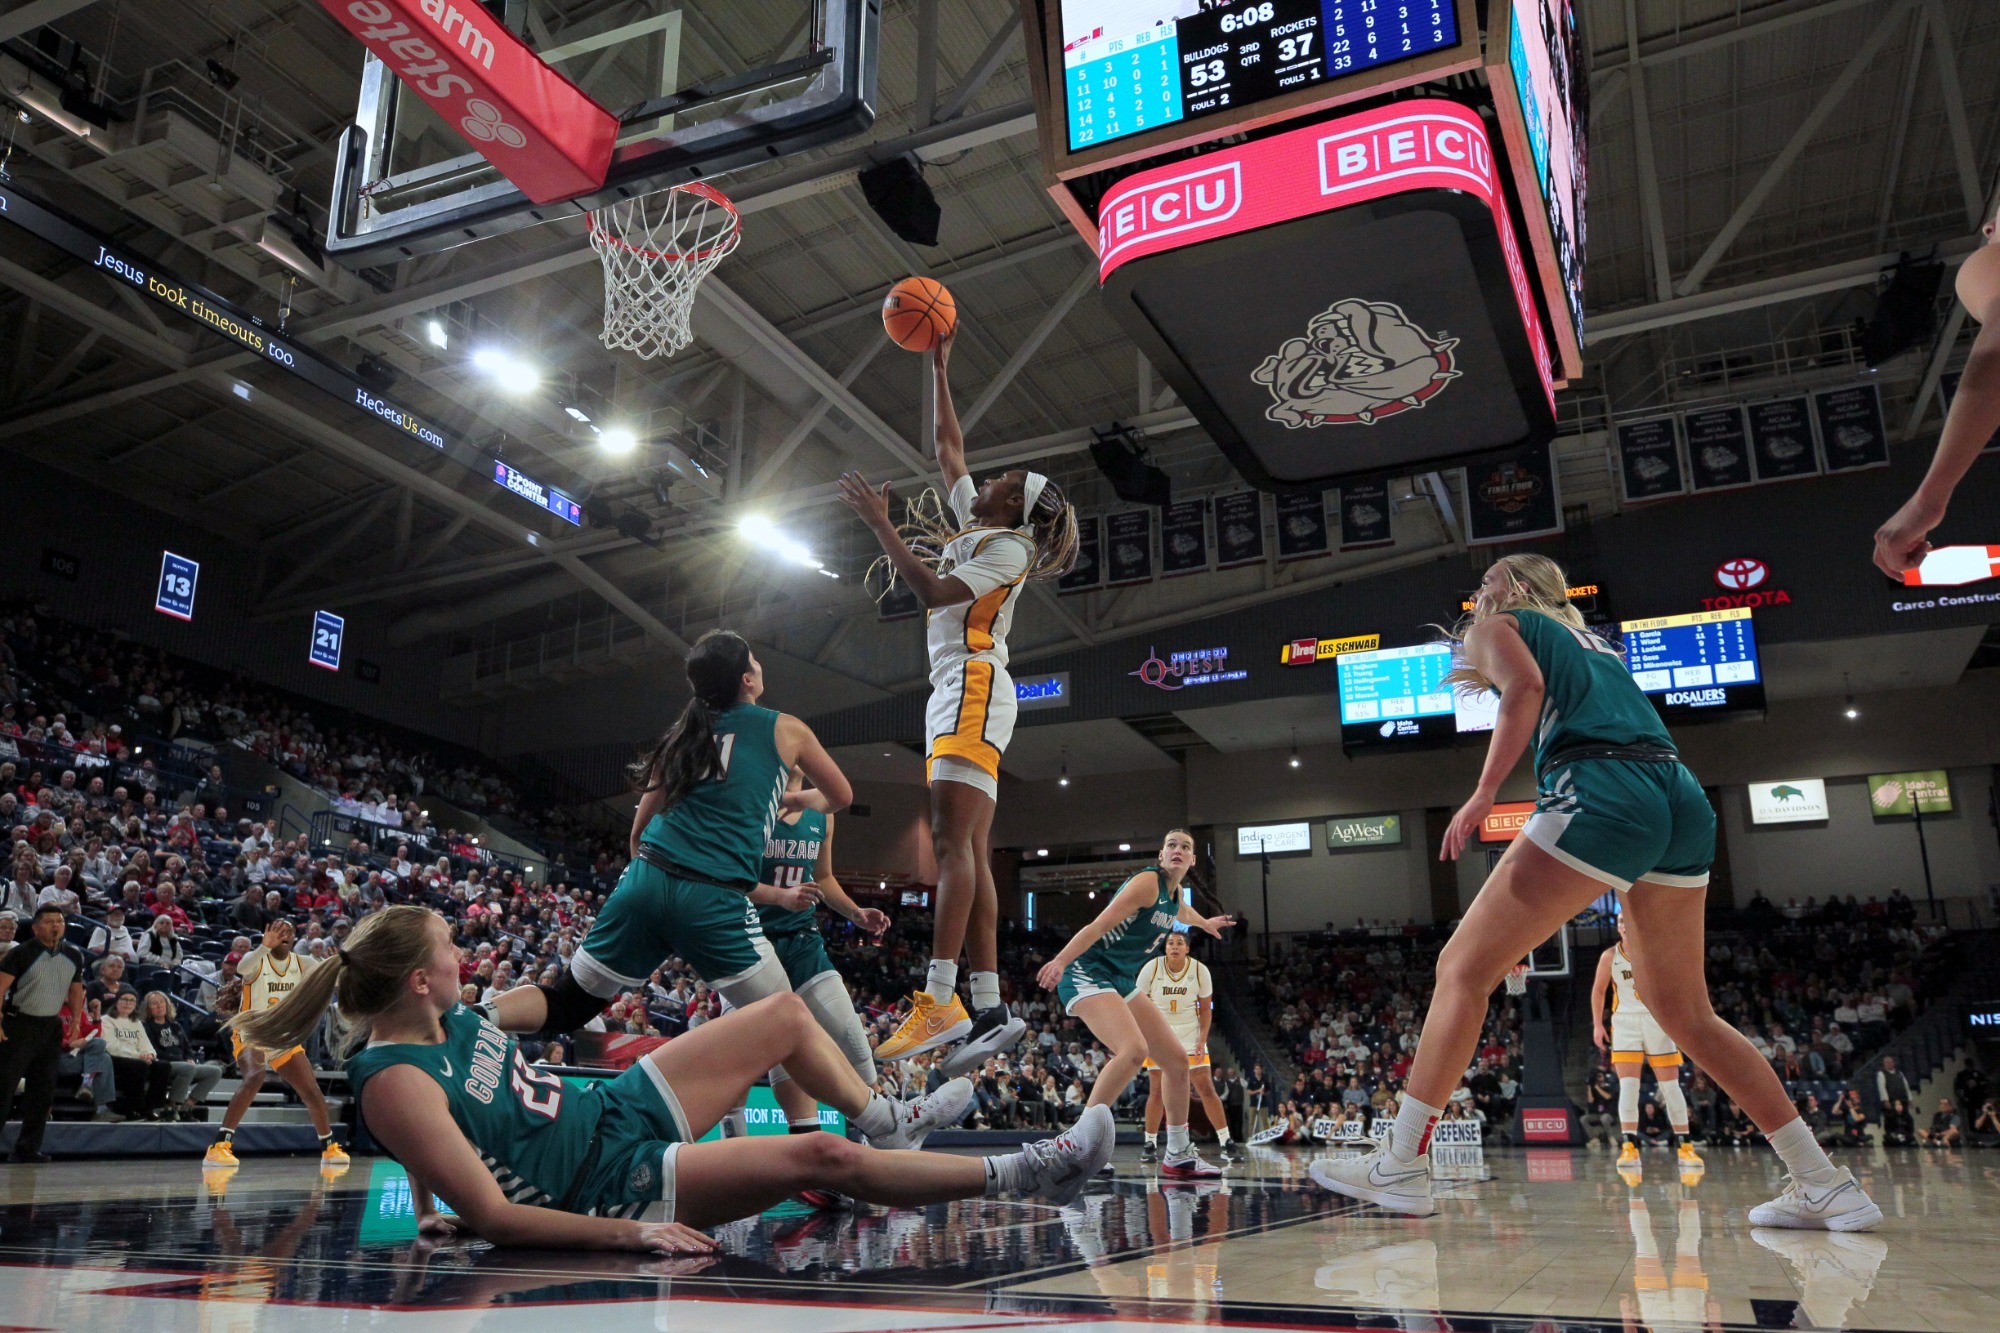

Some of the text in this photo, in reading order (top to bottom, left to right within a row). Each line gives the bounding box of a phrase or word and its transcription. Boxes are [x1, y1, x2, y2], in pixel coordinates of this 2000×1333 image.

[1220, 2, 1275, 33] 6:08
[1334, 0, 1378, 21] 2 11
[1271, 16, 1318, 38] ROCKETS
[1336, 6, 1408, 37] 5 9 3
[1109, 25, 1173, 53] PTS REB FLS
[1333, 13, 1441, 54] 22 6 1 3
[347, 0, 474, 98] State
[1184, 43, 1229, 64] BULLDOGS
[1239, 42, 1260, 55] 3RD
[1278, 32, 1314, 62] 37
[1334, 30, 1443, 70] 33 4 2 3
[1079, 45, 1167, 81] 5 3 2 1
[1241, 54, 1260, 67] QTR
[1077, 60, 1168, 97] 11 10 0 1
[1190, 60, 1226, 87] 53
[1279, 67, 1321, 87] FOULS 1
[1077, 75, 1169, 112] 12 4 5 2
[1191, 94, 1230, 112] FOULS 2
[1079, 90, 1171, 127] 14 5 2 0
[1079, 107, 1172, 143] 22 11 5 1
[1337, 130, 1489, 177] BECU
[94, 246, 295, 367] Jesus took timeouts, too.
[356, 388, 443, 448] HeGetsUs.com
[507, 479, 548, 507] COUNTER
[508, 470, 543, 495] 3-POINT
[1488, 484, 1509, 495] FINAL
[556, 501, 562, 511] 4
[166, 574, 191, 597] 13
[1701, 590, 1791, 611] TOYOTA
[1892, 600, 1935, 611] Garco
[1630, 610, 1740, 629] ON THE FLOOR PTS REB FLS
[316, 628, 338, 650] 21
[1640, 630, 1661, 638] Garcia
[1292, 643, 1315, 658] Tires
[1319, 639, 1376, 654] LES SCHWAB
[1641, 645, 1666, 653] Lockett
[1128, 646, 1227, 690] QUEST
[1727, 663, 1741, 671] AST
[1016, 678, 1061, 699] bank
[1665, 688, 1726, 705] ROSAUERS
[1906, 780, 1936, 789] Idaho
[1907, 788, 1948, 798] Central
[1775, 805, 1821, 813] DAVIDSON
[1274, 831, 1306, 839] URGENT
[1332, 823, 1384, 842] AgWest
[764, 839, 820, 860] ONZAG
[1151, 910, 1174, 929] GONZ
[1162, 986, 1188, 996] TOLEDO
[1169, 1000, 1177, 1013] 1
[465, 1020, 508, 1104] GONZAG
[1253, 1124, 1284, 1141] NOISE
[1435, 1123, 1476, 1142] DEFENSE
[1527, 1121, 1563, 1129] BECU
